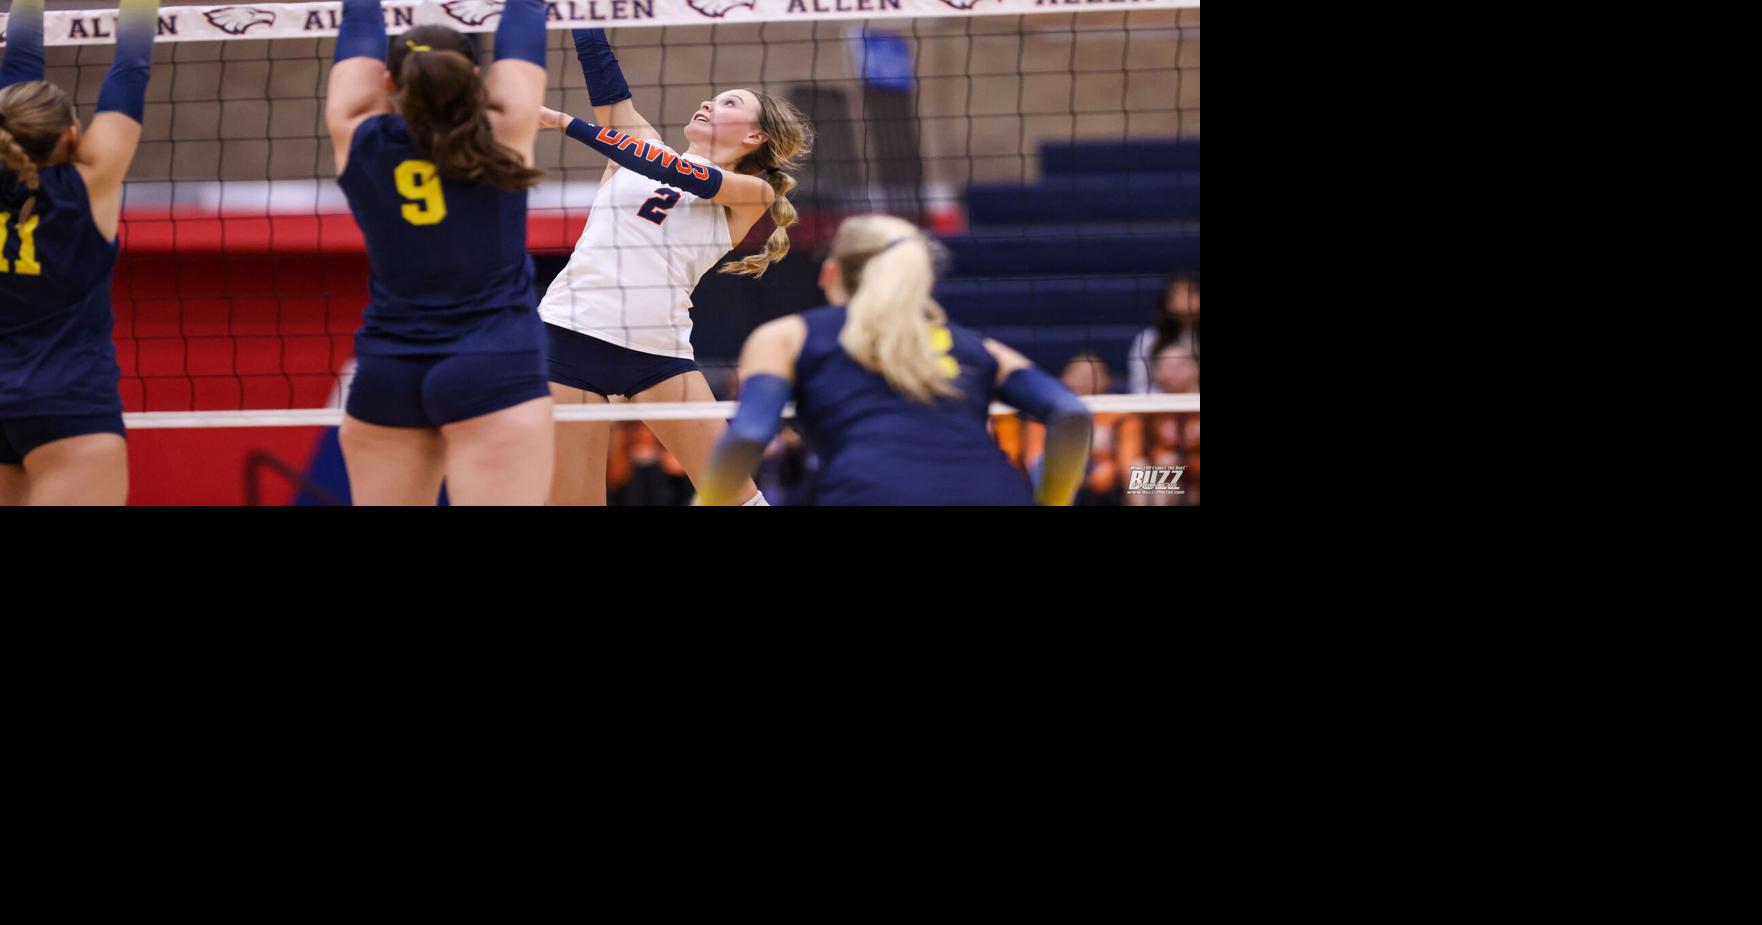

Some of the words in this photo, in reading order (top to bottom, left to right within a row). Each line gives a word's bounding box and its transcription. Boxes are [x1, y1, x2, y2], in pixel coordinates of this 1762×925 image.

[304, 7, 414, 30] ALN
[545, 0, 654, 20] ALLEN
[69, 15, 178, 38] ALN
[393, 159, 449, 226] 9
[637, 187, 682, 226] 2
